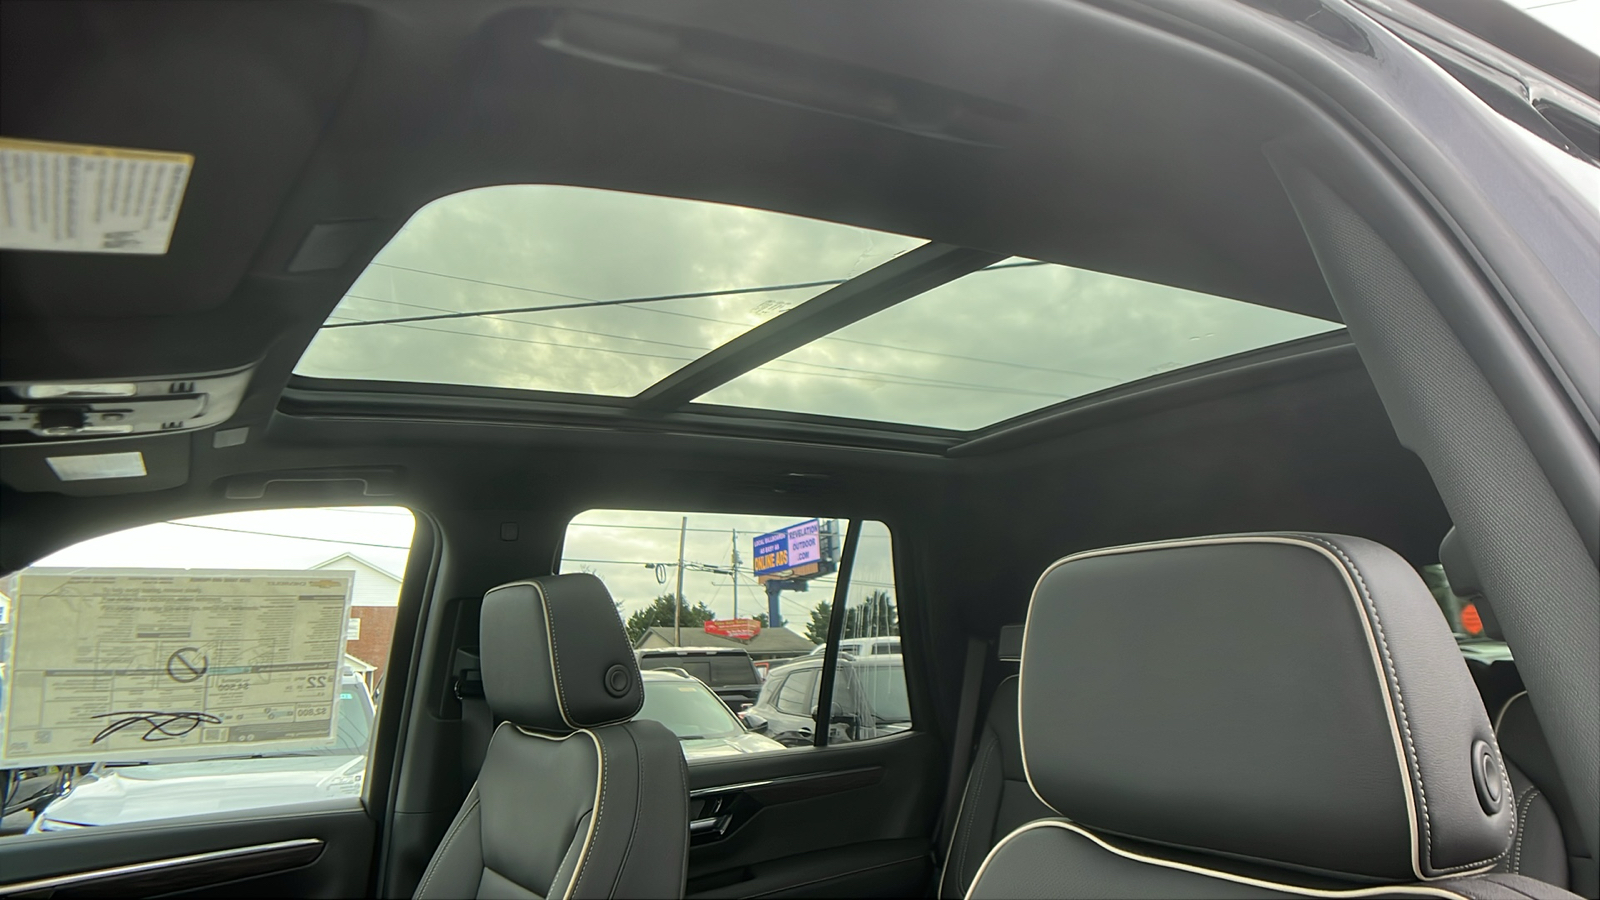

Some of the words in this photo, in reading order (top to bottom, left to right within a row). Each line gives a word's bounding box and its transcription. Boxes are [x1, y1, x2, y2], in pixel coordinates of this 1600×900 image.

[789, 525, 818, 540] REVELATION
[793, 538, 816, 551] OUTDOOR
[755, 553, 775, 571] ONLINE
[776, 550, 787, 566] ADS
[798, 551, 810, 561] .COM
